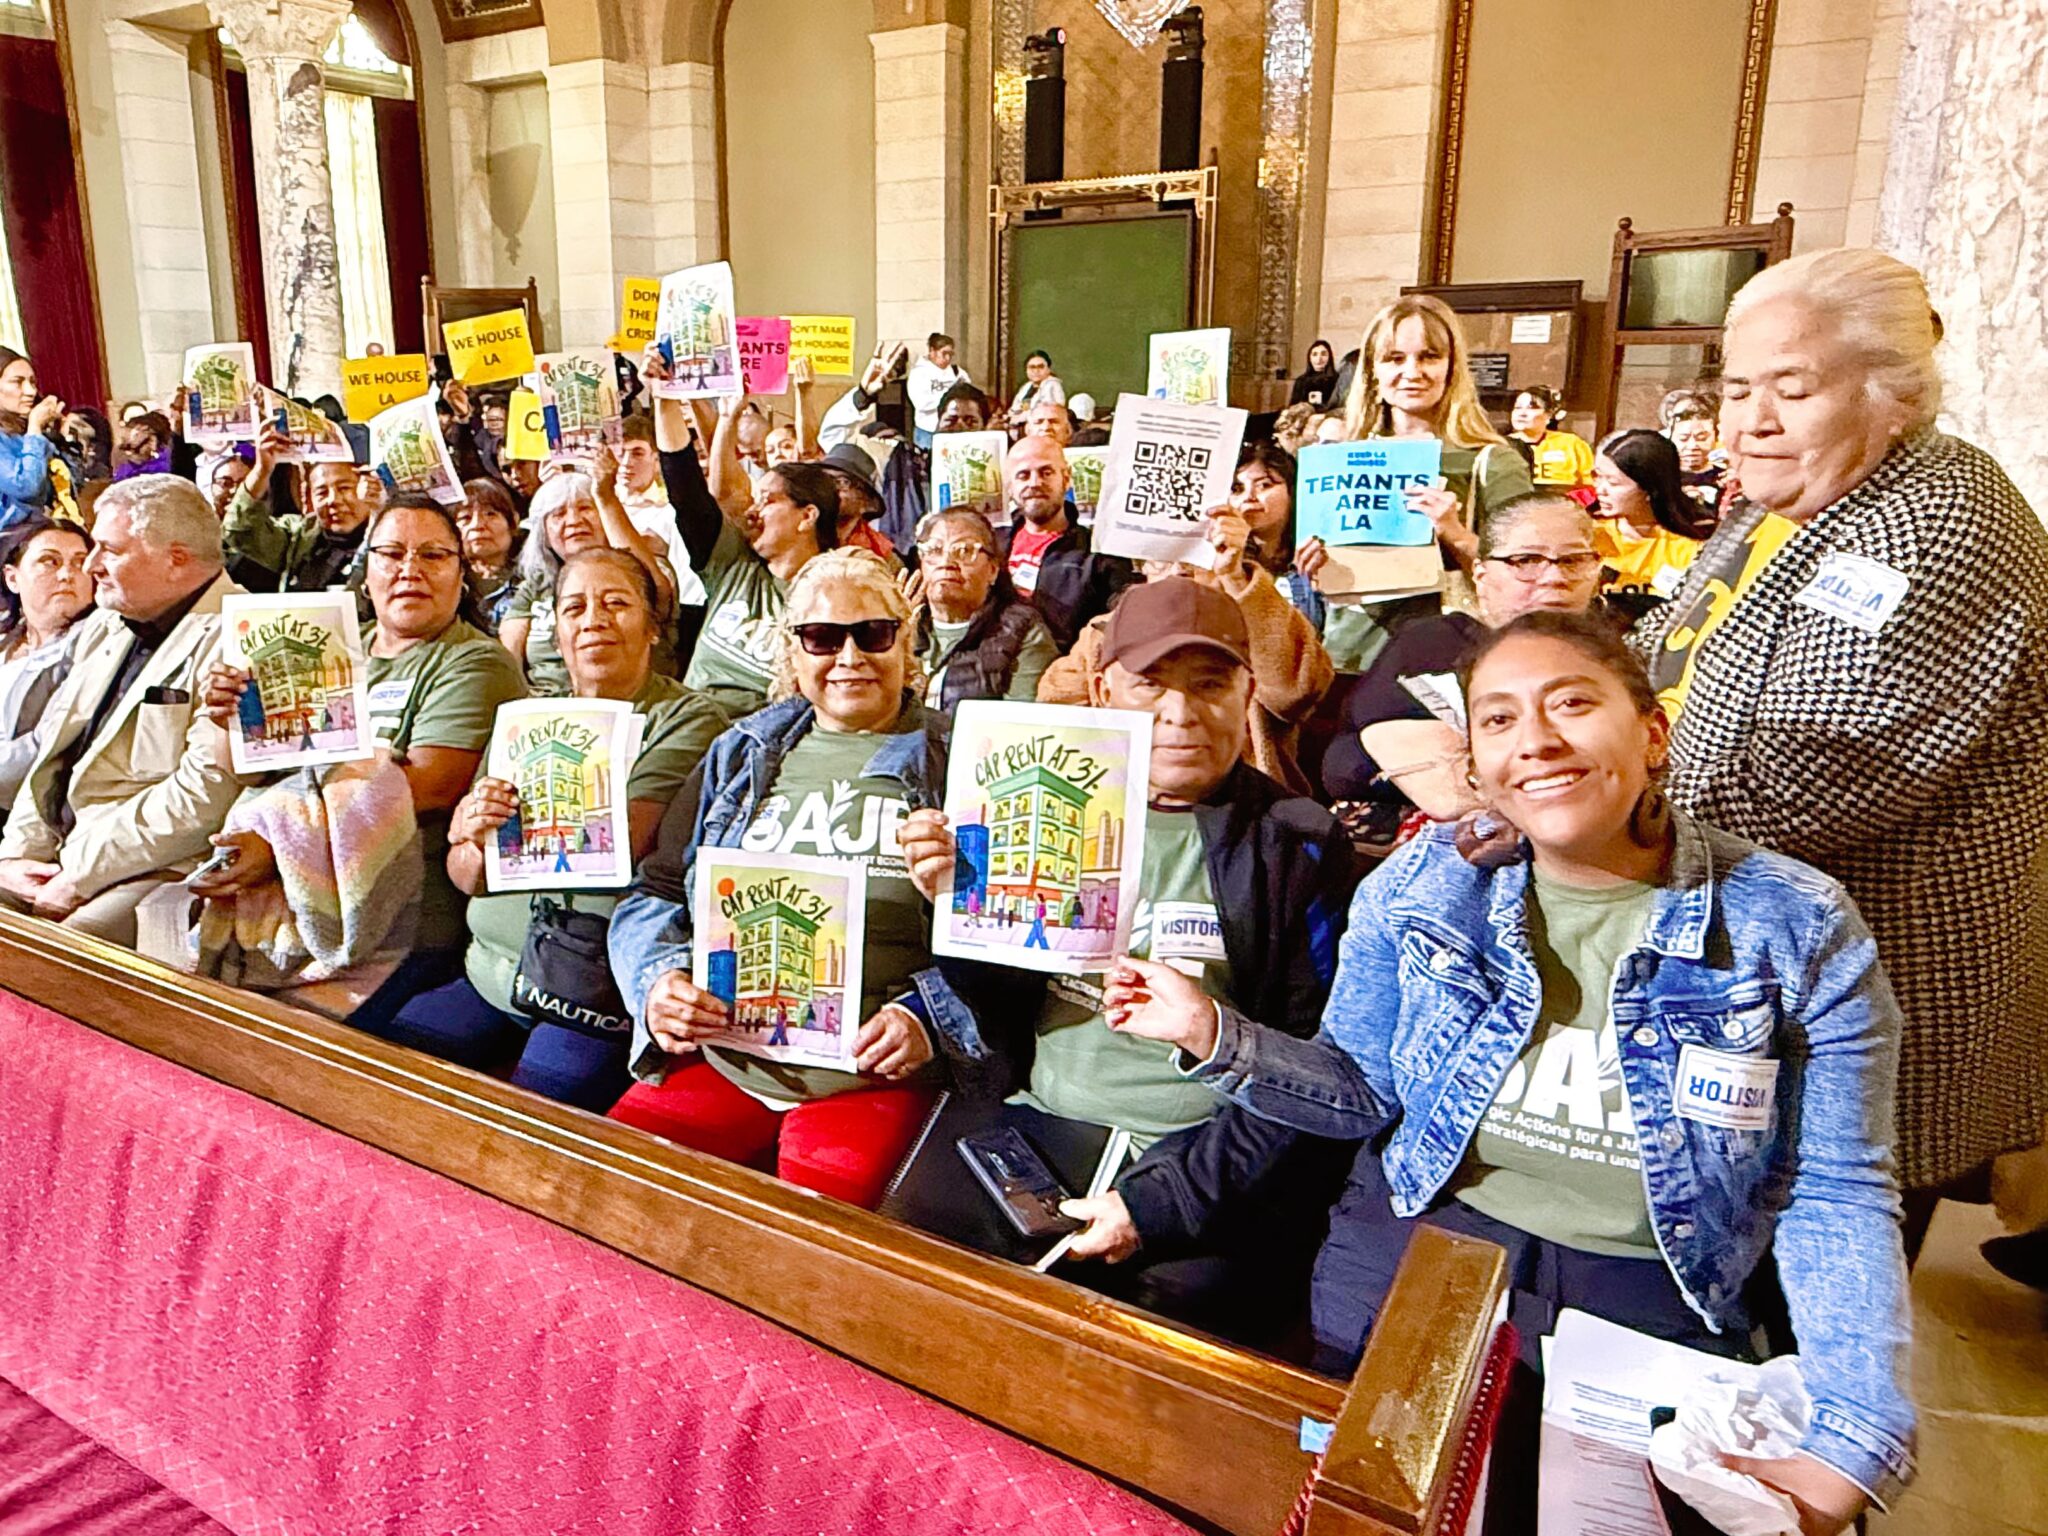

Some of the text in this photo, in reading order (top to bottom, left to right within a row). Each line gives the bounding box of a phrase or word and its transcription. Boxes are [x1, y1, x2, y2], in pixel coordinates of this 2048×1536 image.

[633, 288, 660, 302] DON
[629, 308, 651, 321] THE
[452, 325, 523, 351] WE HOUSE
[626, 328, 655, 340] CRISI
[739, 342, 785, 355] ANTS
[483, 353, 501, 367] LA
[740, 357, 762, 370] RE
[348, 370, 421, 386] WE HOUSE
[379, 393, 396, 406] LA
[1305, 474, 1430, 494] TENANTS
[1335, 494, 1391, 511] ARE
[1341, 514, 1372, 531] LA
[259, 614, 291, 646] RENT
[289, 620, 309, 638] AT
[529, 717, 564, 750] RENT
[559, 723, 580, 741] AT
[975, 735, 1109, 790] CAP RENT AT 3%
[721, 890, 744, 918] CAP
[746, 876, 790, 909] RENT
[784, 884, 810, 905] AT
[1161, 919, 1221, 937] VISITOR
[528, 986, 630, 1032] NAUTICA
[1487, 1105, 1640, 1152] gic Actions for a Ju
[1480, 1121, 1641, 1170] stratégicas para una
